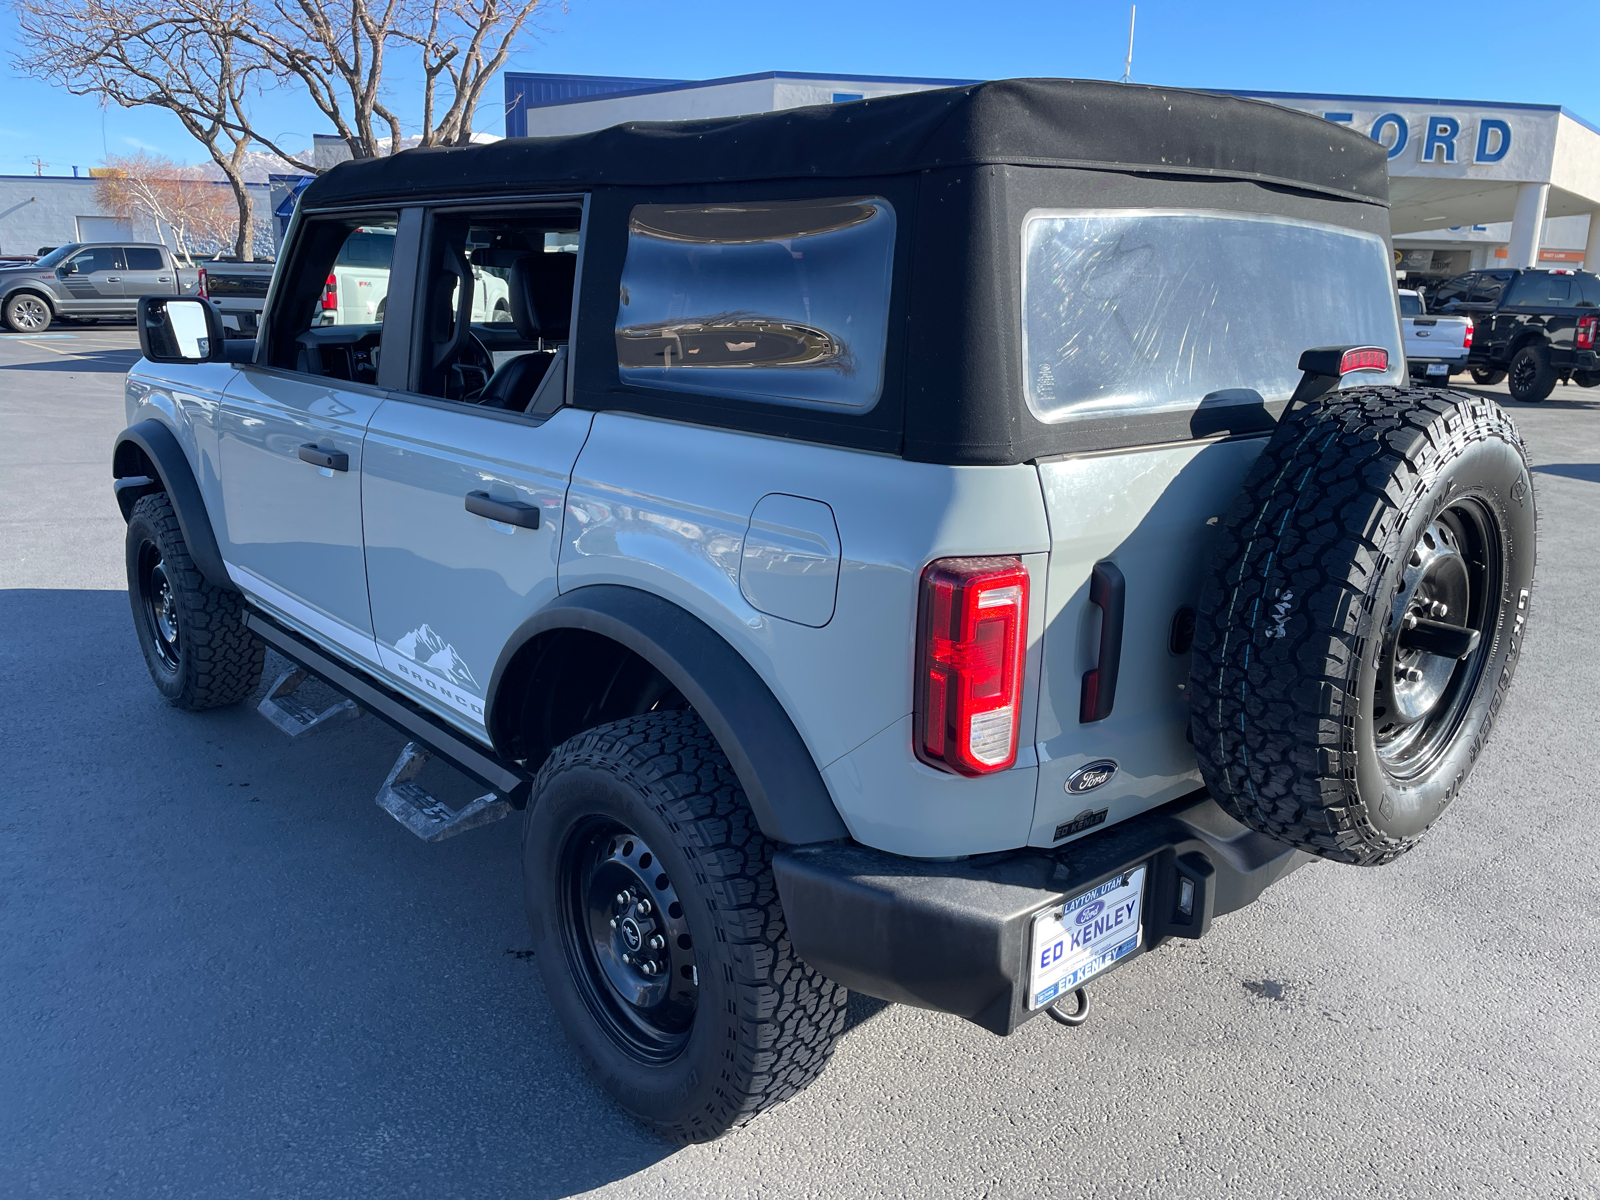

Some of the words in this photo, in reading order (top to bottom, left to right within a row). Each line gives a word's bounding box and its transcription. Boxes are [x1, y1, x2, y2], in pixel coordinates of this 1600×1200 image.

[1323, 112, 1512, 165] ORD
[397, 662, 483, 716] BRONCO
[1078, 766, 1109, 790] Ford
[1055, 825, 1069, 838] ED
[1070, 811, 1107, 832] KENLEY
[1101, 876, 1122, 896] UTAH
[1080, 903, 1100, 923] Ford
[1040, 940, 1064, 969] ED
[1070, 899, 1136, 952] KENLEY
[1059, 973, 1074, 990] ED
[1076, 947, 1119, 982] KENLEY
